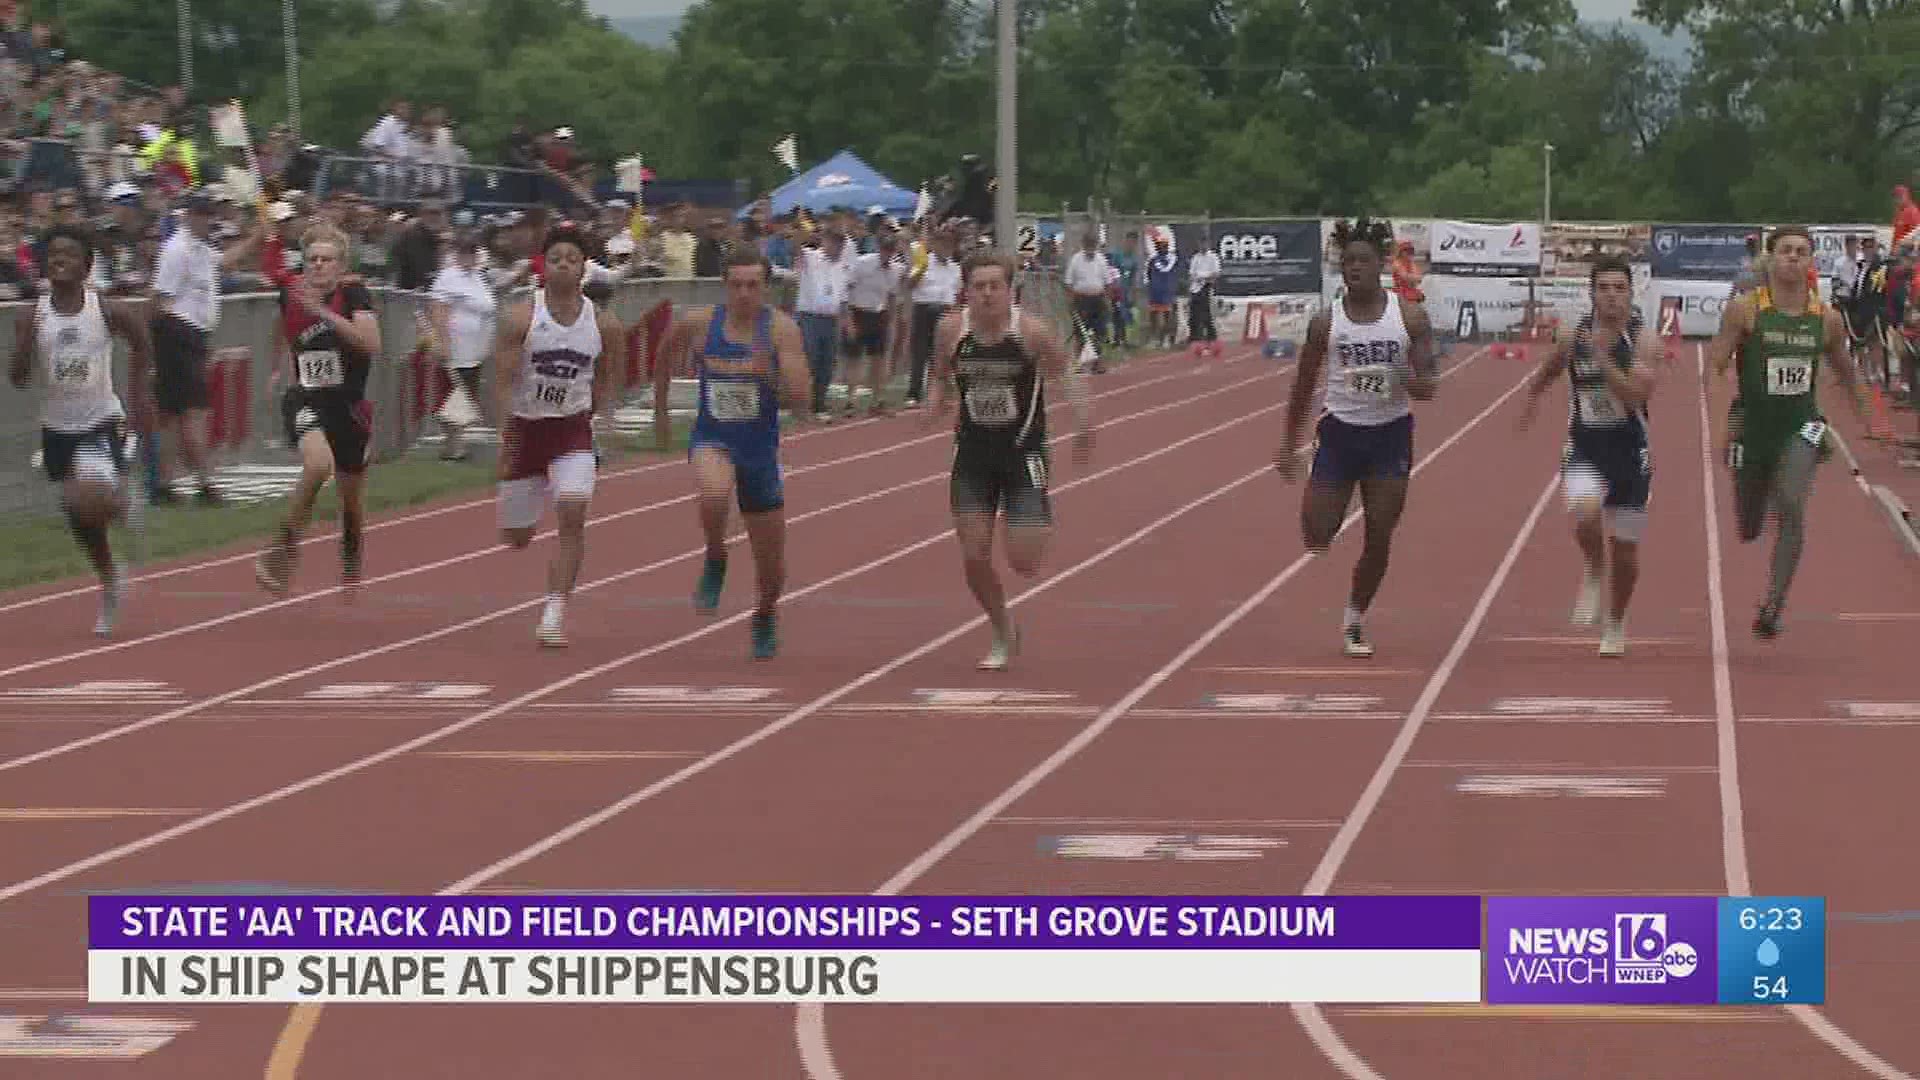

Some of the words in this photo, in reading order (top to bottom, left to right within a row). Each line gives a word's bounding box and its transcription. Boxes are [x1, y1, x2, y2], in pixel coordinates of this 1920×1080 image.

[1018, 226, 1036, 251] 2
[1336, 340, 1401, 365] PREP
[1777, 366, 1806, 385] 152
